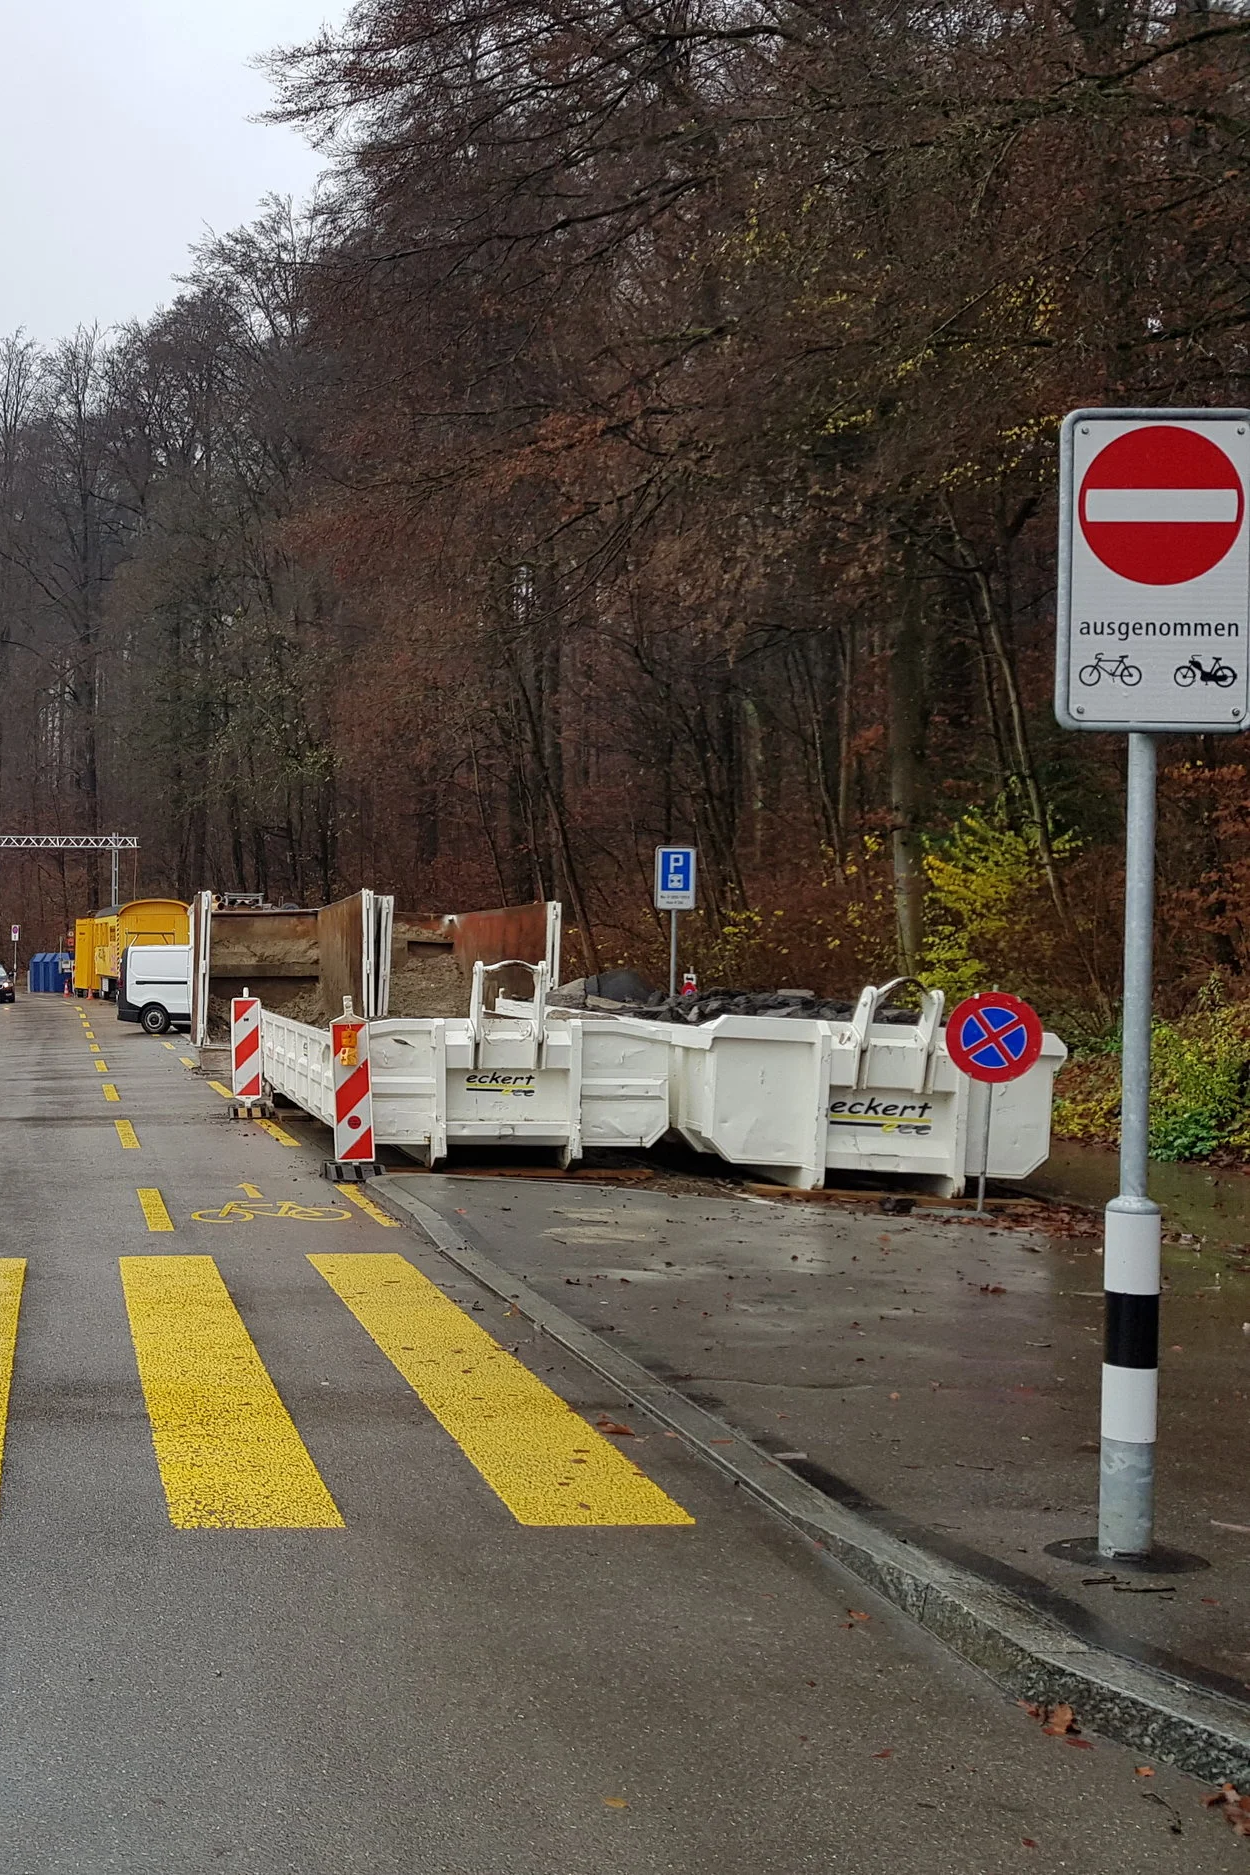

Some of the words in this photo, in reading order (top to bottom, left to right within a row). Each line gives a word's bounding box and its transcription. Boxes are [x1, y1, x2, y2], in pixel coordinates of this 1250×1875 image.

[1079, 619, 1239, 640] ausgenommen
[670, 854, 684, 873] P
[466, 1071, 535, 1085] eckert
[830, 1097, 932, 1118] eckert
